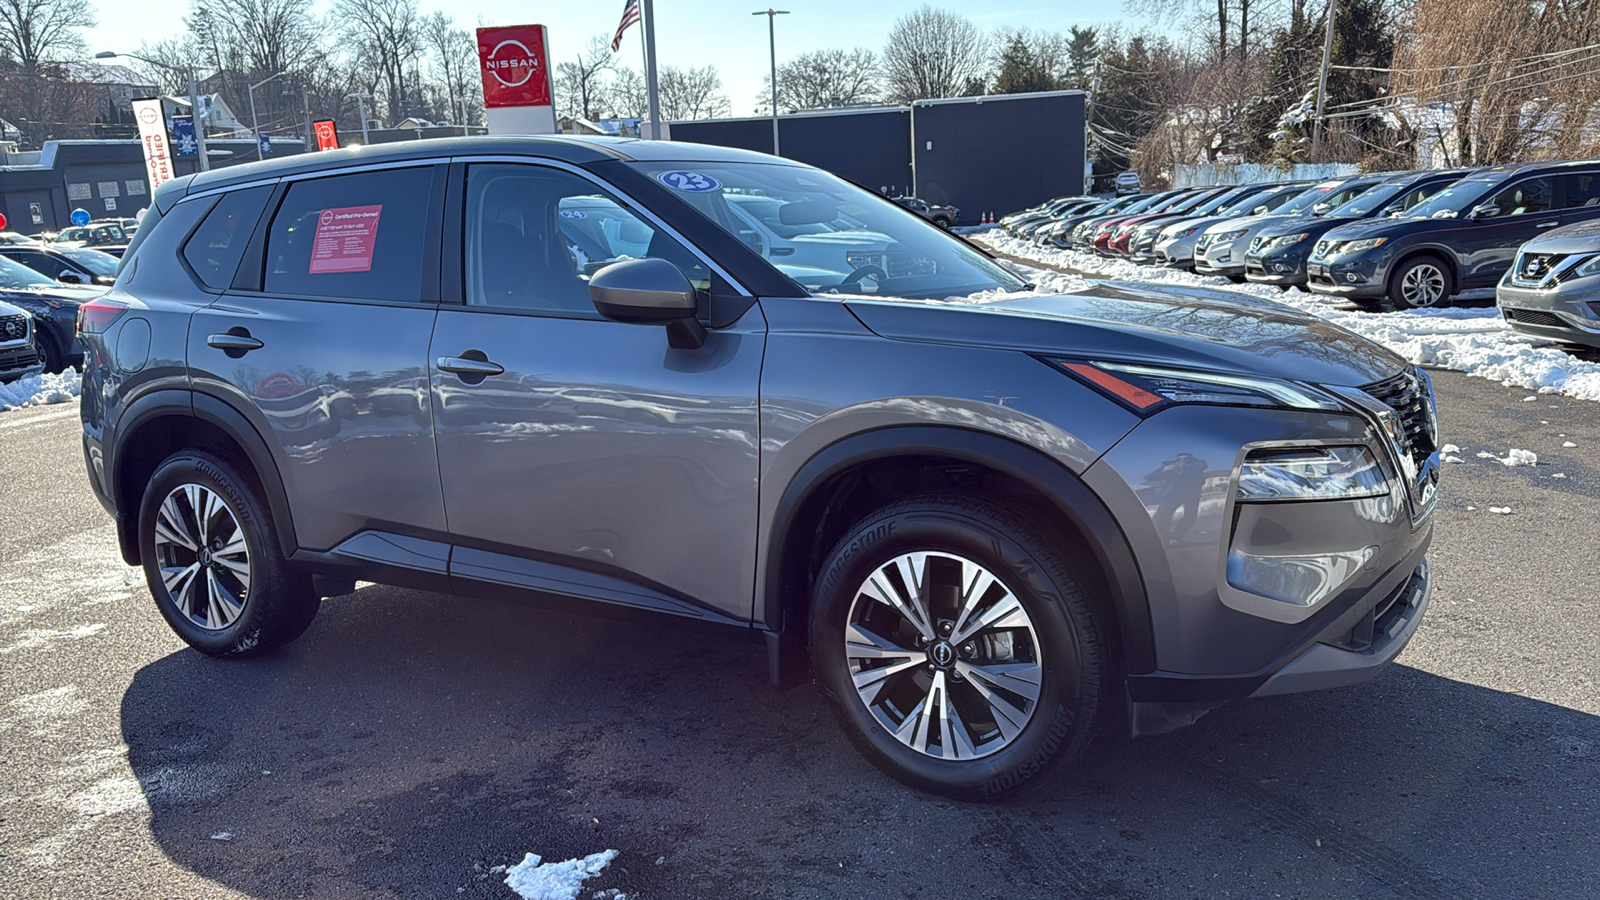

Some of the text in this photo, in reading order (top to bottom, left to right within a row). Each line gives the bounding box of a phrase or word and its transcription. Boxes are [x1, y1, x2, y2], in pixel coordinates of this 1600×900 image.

[486, 58, 538, 68] NISSAN
[669, 172, 710, 190] 23
[195, 461, 254, 526] BRIDGESTONE
[818, 521, 896, 599] RIDGESTONE
